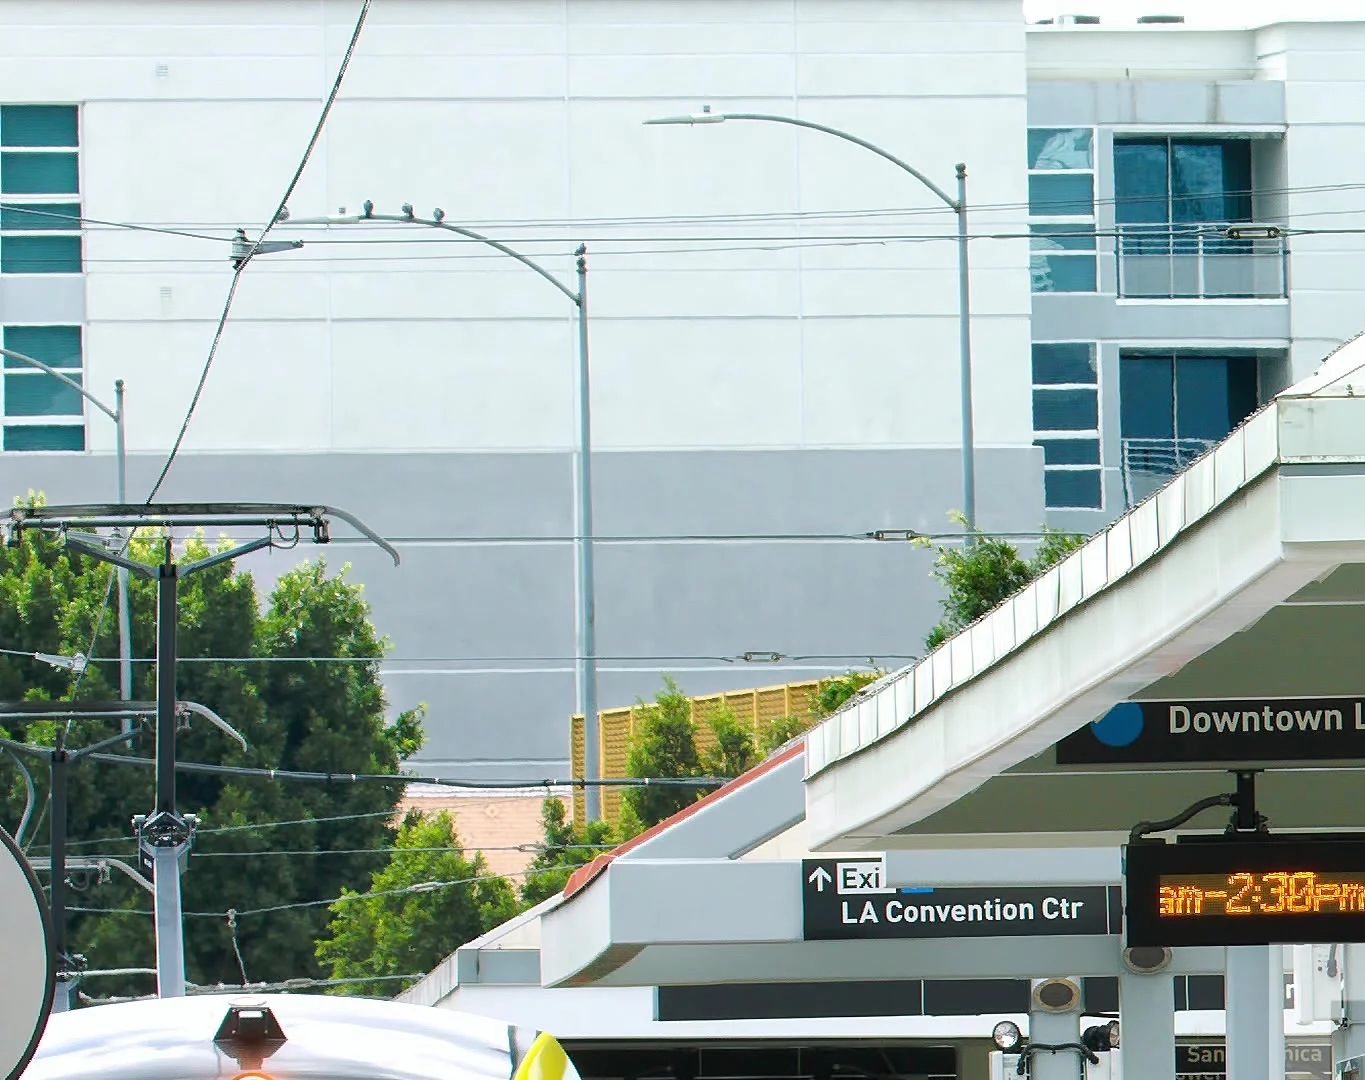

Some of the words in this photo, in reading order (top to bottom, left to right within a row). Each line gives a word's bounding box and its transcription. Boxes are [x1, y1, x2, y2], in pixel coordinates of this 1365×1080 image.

[1169, 704, 1343, 734] Downtown
[842, 867, 880, 889] Exi
[841, 901, 879, 924] LA
[885, 898, 1034, 923] Convention
[1041, 896, 1084, 920] Ctr
[1187, 1046, 1224, 1063] San
